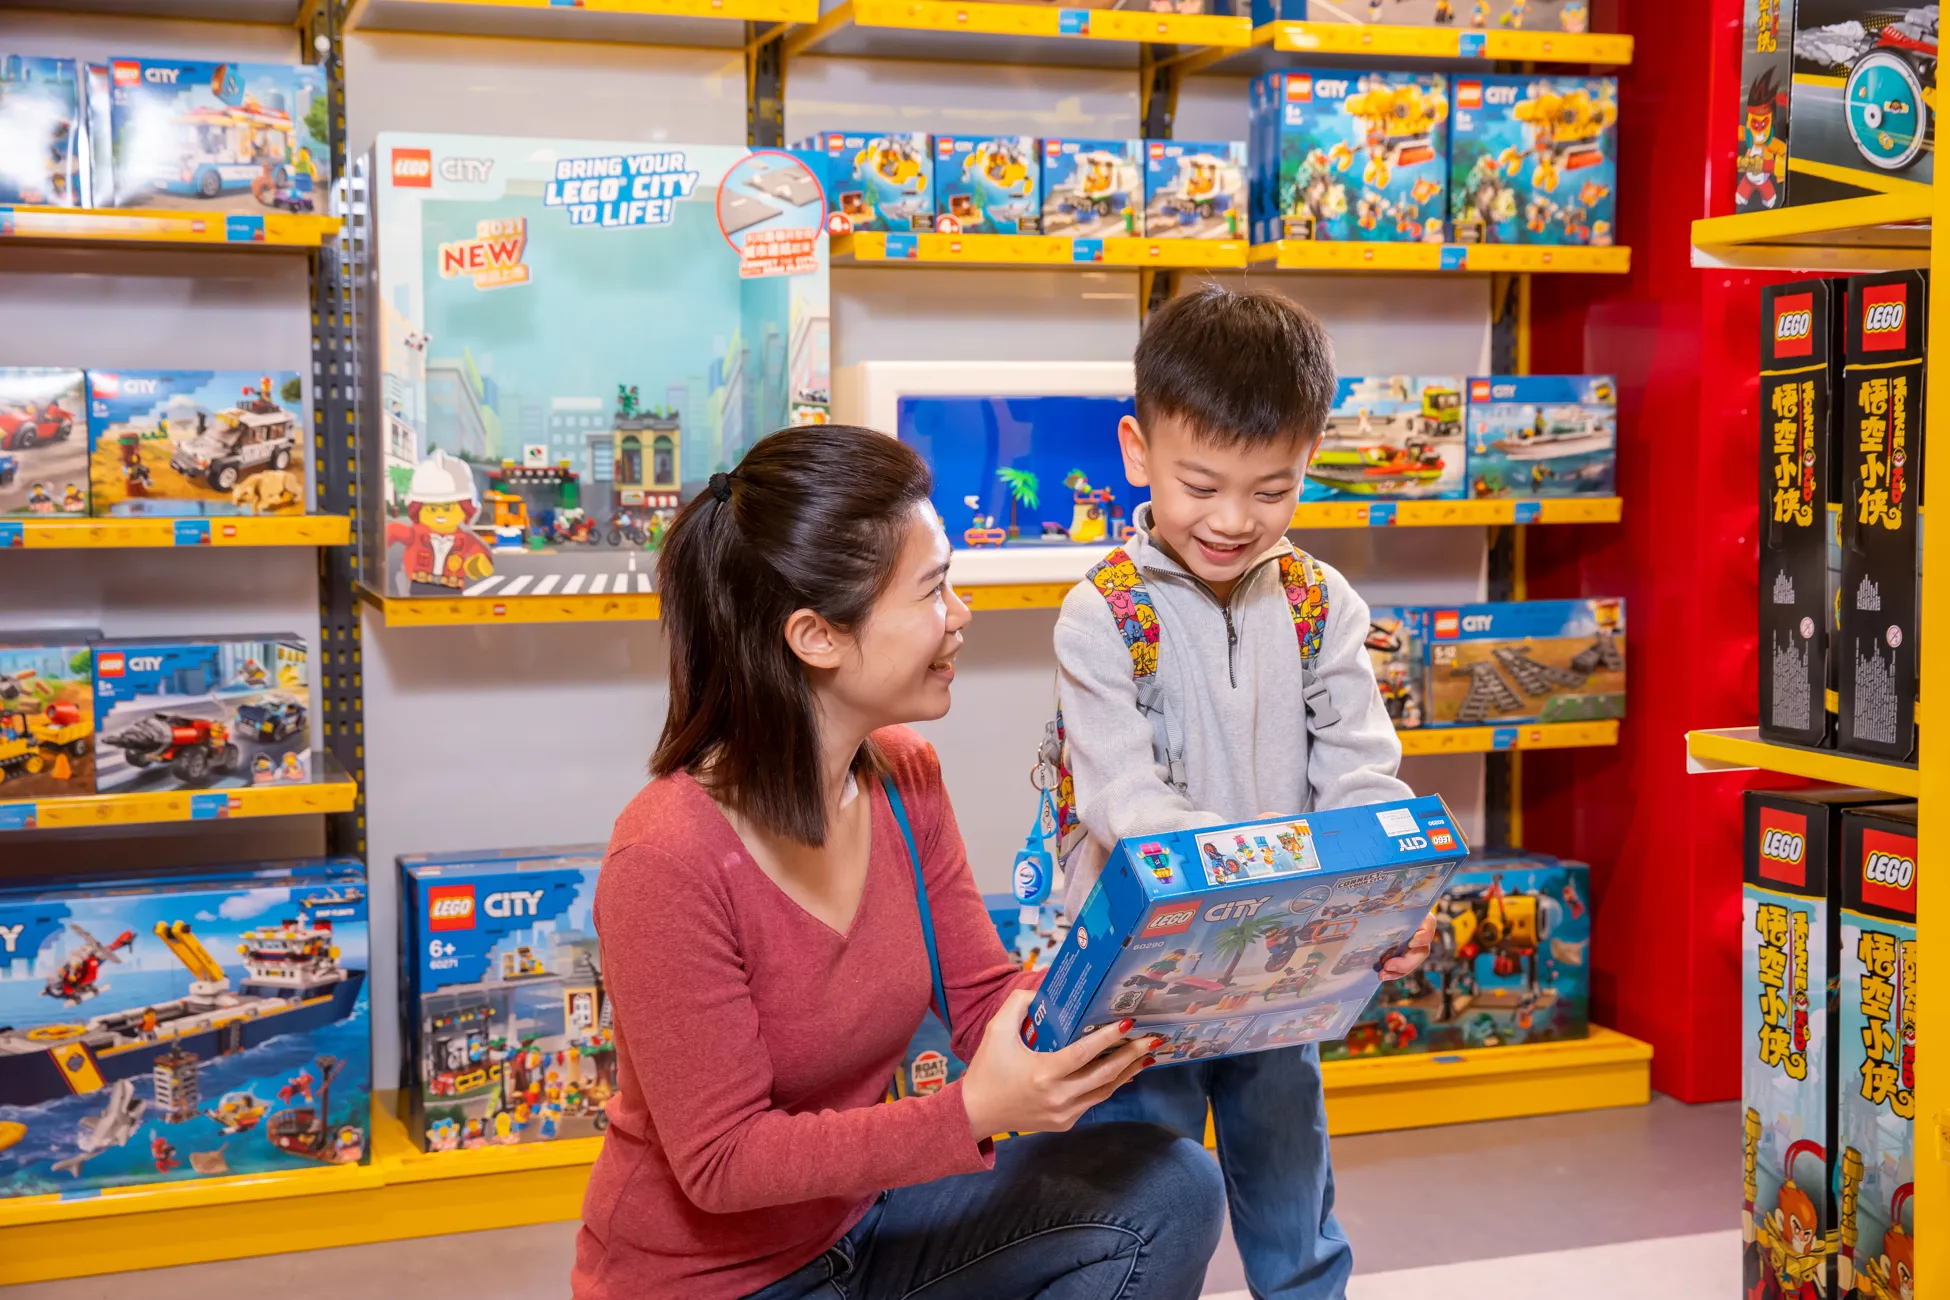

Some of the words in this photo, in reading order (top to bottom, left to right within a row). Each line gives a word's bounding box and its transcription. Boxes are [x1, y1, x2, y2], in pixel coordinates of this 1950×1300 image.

[144, 67, 180, 84] CITY
[394, 160, 430, 177] LEGO
[440, 158, 493, 183] CITY
[557, 158, 622, 180] BRING
[628, 154, 684, 175] YOUR
[632, 172, 698, 199] CITY
[569, 204, 597, 224] TO
[602, 199, 671, 226] LIFE!
[444, 239, 518, 272] NEW
[1777, 311, 1810, 339] LEGO
[1865, 303, 1905, 332] LEGO
[124, 379, 157, 394] CITY
[1462, 615, 1493, 632] CITY
[128, 656, 163, 671] CITY
[1398, 836, 1428, 852] CITY
[1432, 835, 1451, 845] LEGO
[1763, 830, 1803, 862] LEGO
[1865, 853, 1914, 889] LEGO
[431, 897, 473, 918] LEGO
[484, 889, 545, 918] CITY
[1149, 910, 1194, 929] LEGO
[1203, 896, 1272, 923] CITY
[429, 939, 456, 957] 6+
[1133, 940, 1165, 951] 60290
[1793, 911, 1809, 991] MONKIE
[1756, 903, 1807, 1081] 悟空小侠
[1034, 999, 1047, 1026] CITY
[1859, 930, 1916, 1120] 悟空小侠
[915, 1060, 944, 1073] BOAT
